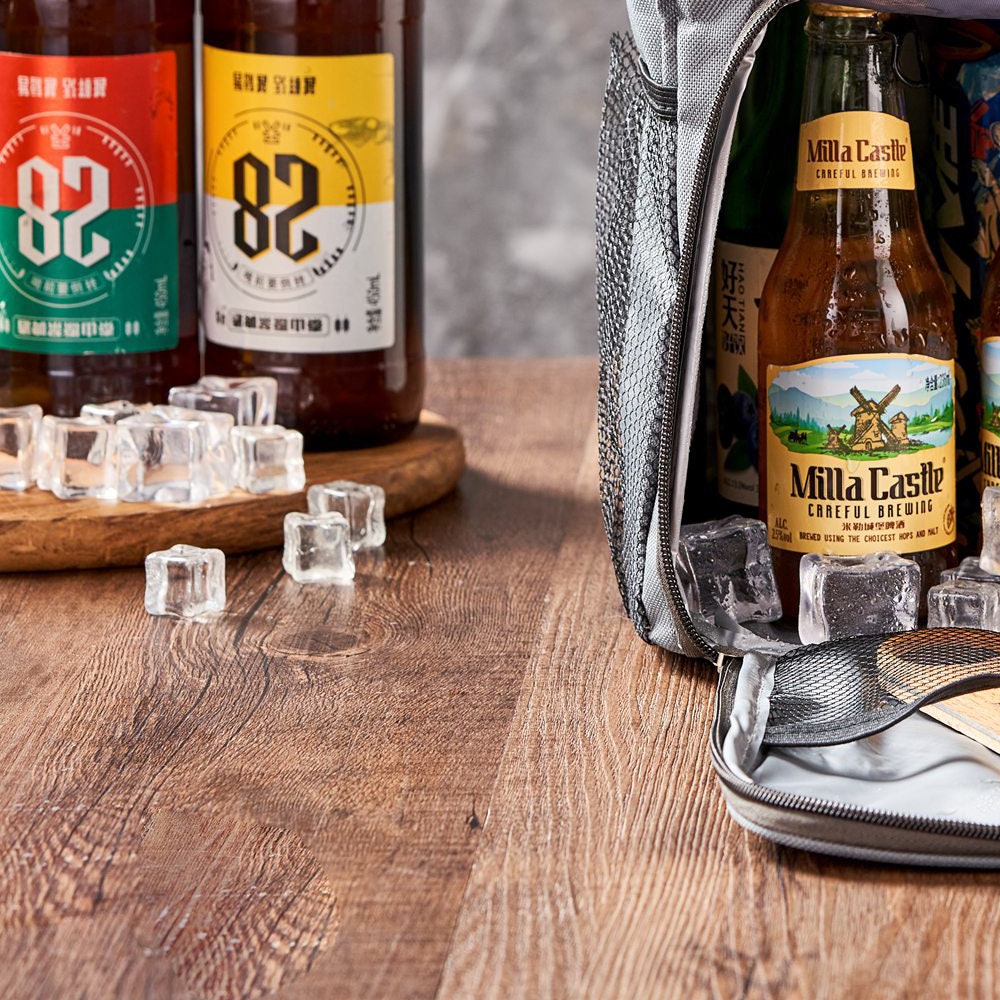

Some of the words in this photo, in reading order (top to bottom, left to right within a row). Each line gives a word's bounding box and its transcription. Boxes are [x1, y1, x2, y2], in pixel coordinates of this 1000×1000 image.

[807, 139, 852, 162] Milla
[855, 138, 907, 162] Castle
[816, 168, 856, 179] CAREFUL
[861, 168, 900, 179] BREWING
[790, 463, 864, 501] Milla
[868, 461, 944, 500] Castle
[808, 503, 870, 518] CAREFUL
[878, 499, 933, 518] BREWING
[799, 531, 821, 541] BREWED
[824, 533, 844, 543] USING
[848, 534, 860, 543] THE
[864, 533, 896, 543] CHOICEST
[899, 531, 913, 541] HOPS
[916, 529, 926, 538] AND
[928, 526, 939, 536] MALT
